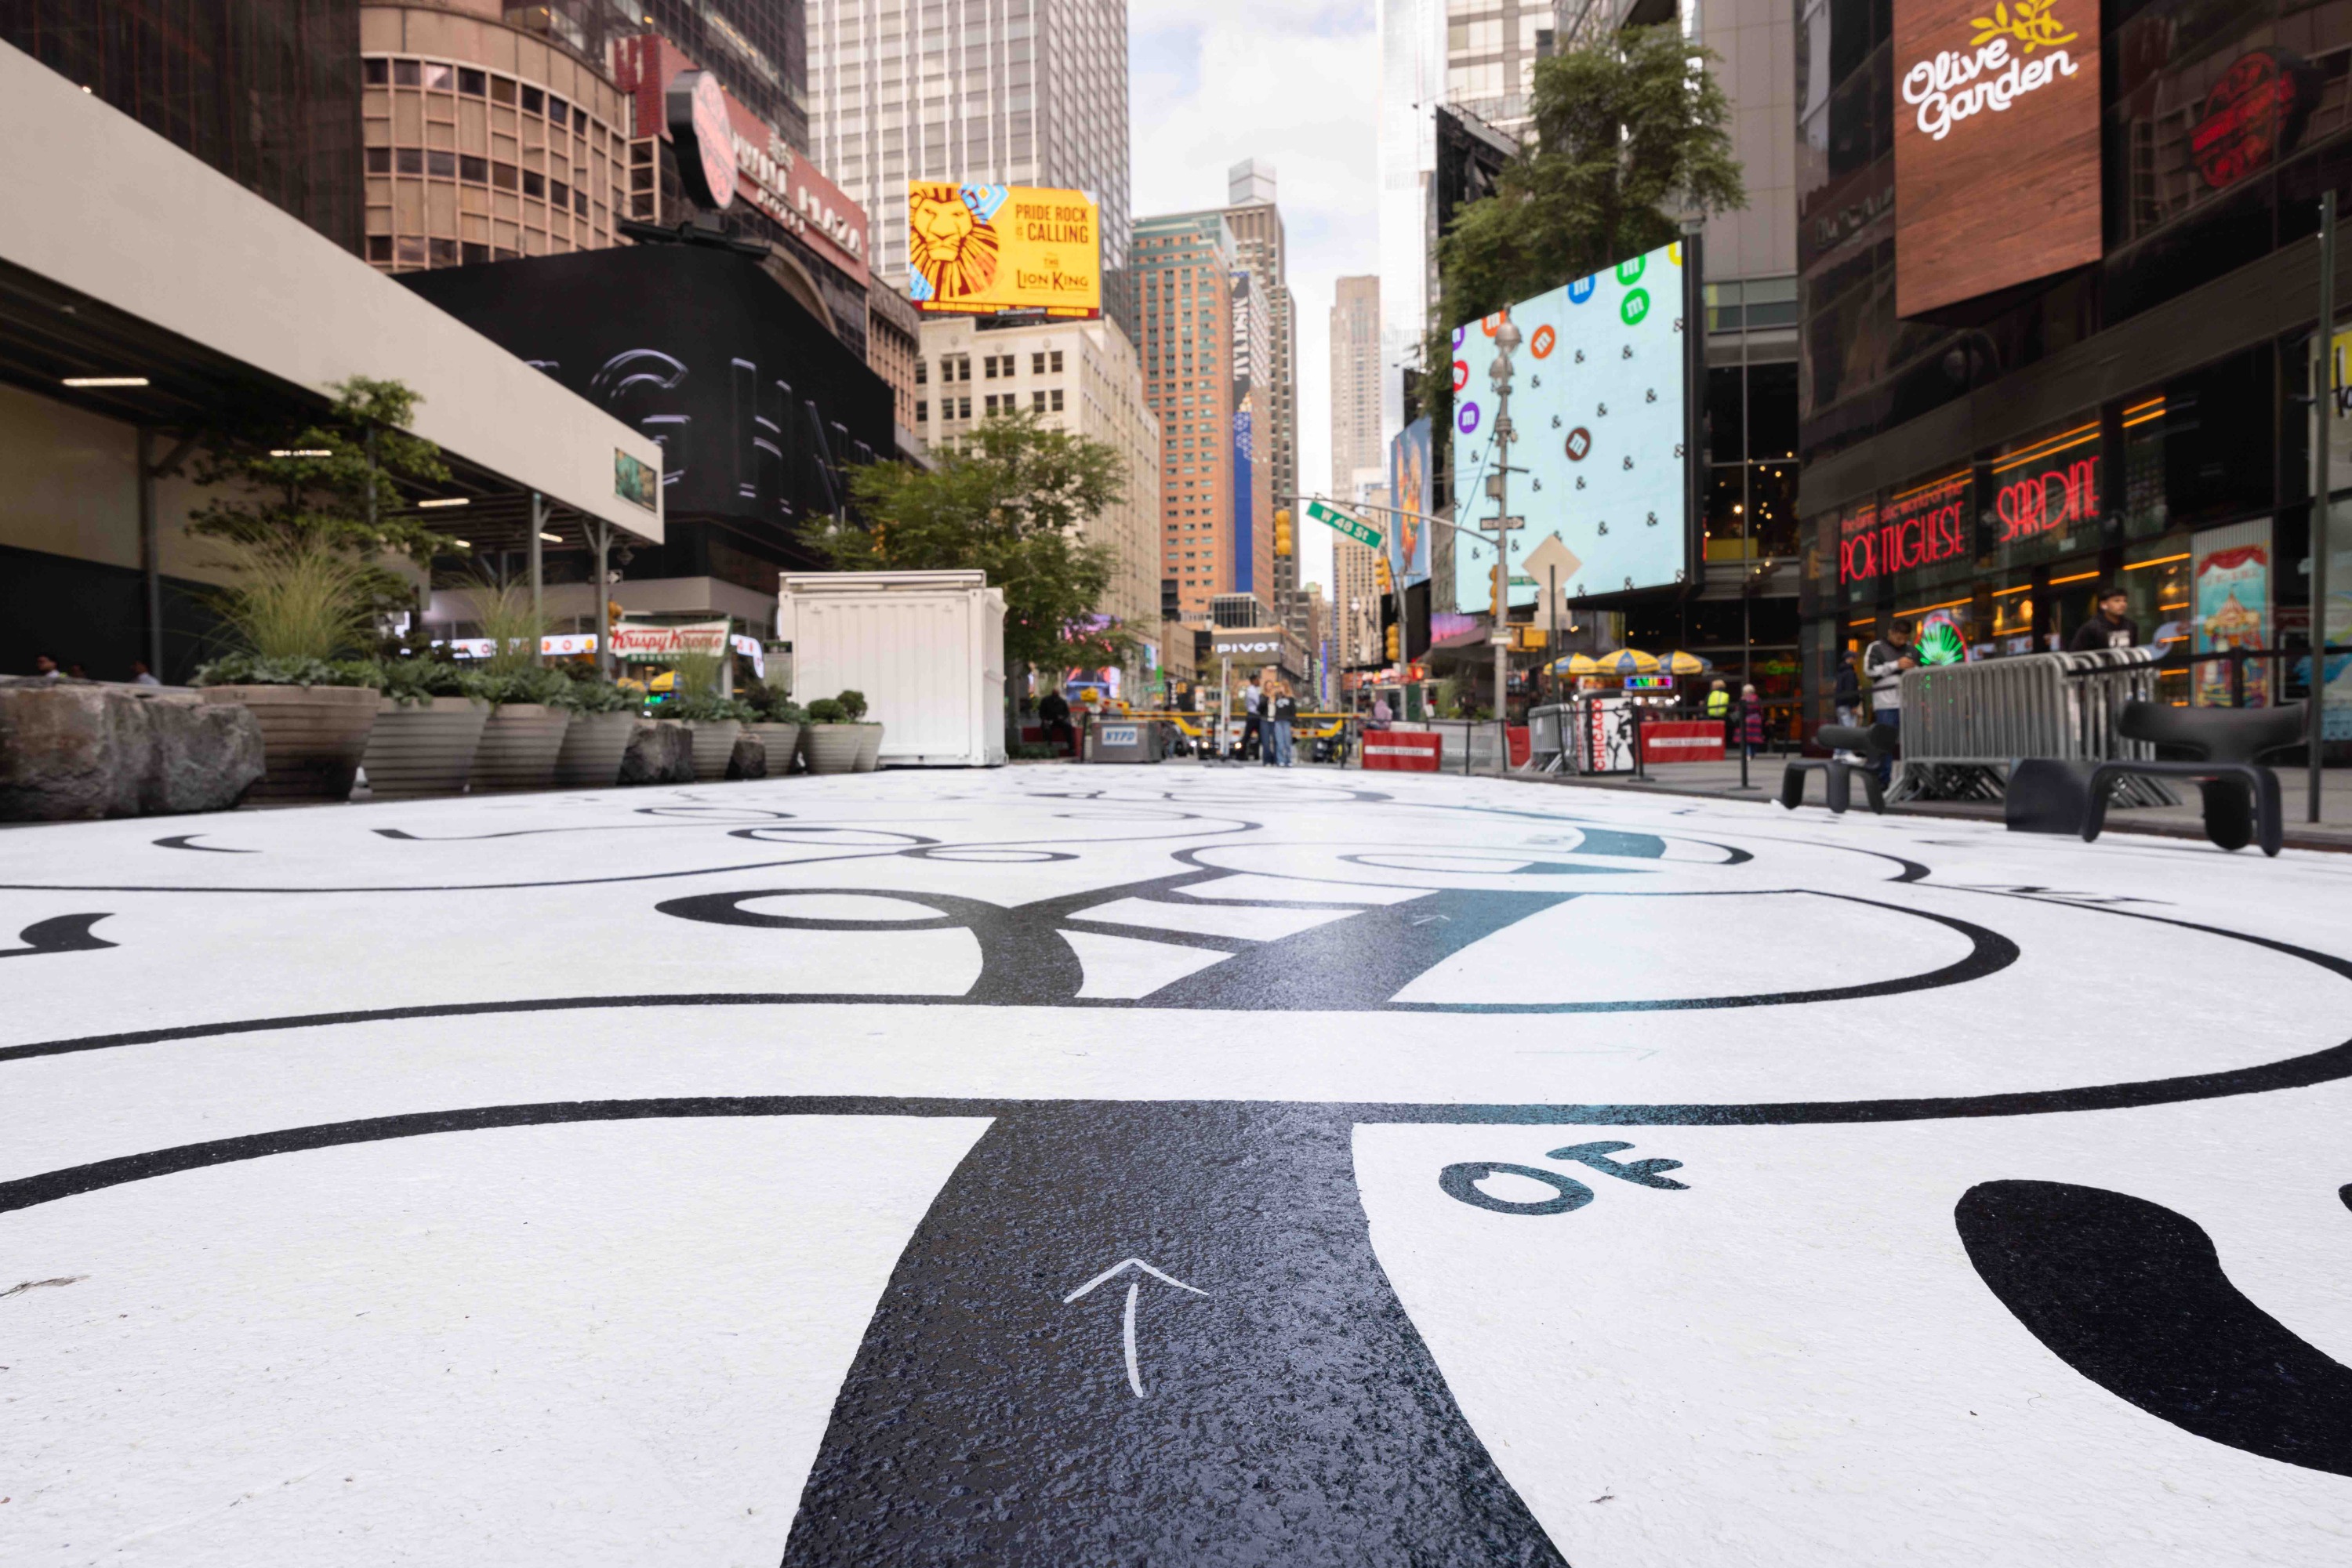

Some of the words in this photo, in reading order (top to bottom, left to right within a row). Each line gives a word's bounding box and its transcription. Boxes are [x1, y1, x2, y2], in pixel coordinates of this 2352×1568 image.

[1902, 38, 2011, 104] Olive
[1917, 49, 2079, 141] Garden
[1015, 204, 1051, 220] PRIDE
[1055, 206, 1087, 223] ROCK
[1028, 223, 1088, 244] CALLING
[1320, 509, 1333, 523] W
[1997, 456, 2100, 543] SARDINE
[1840, 500, 1965, 585] PORTUGUESE
[612, 630, 669, 652] Krispy
[1216, 641, 1280, 654] PIVOT
[1105, 730, 1135, 742] NYPD
[1592, 699, 1606, 771] CHICAGO
[1439, 1141, 1691, 1216] OF
